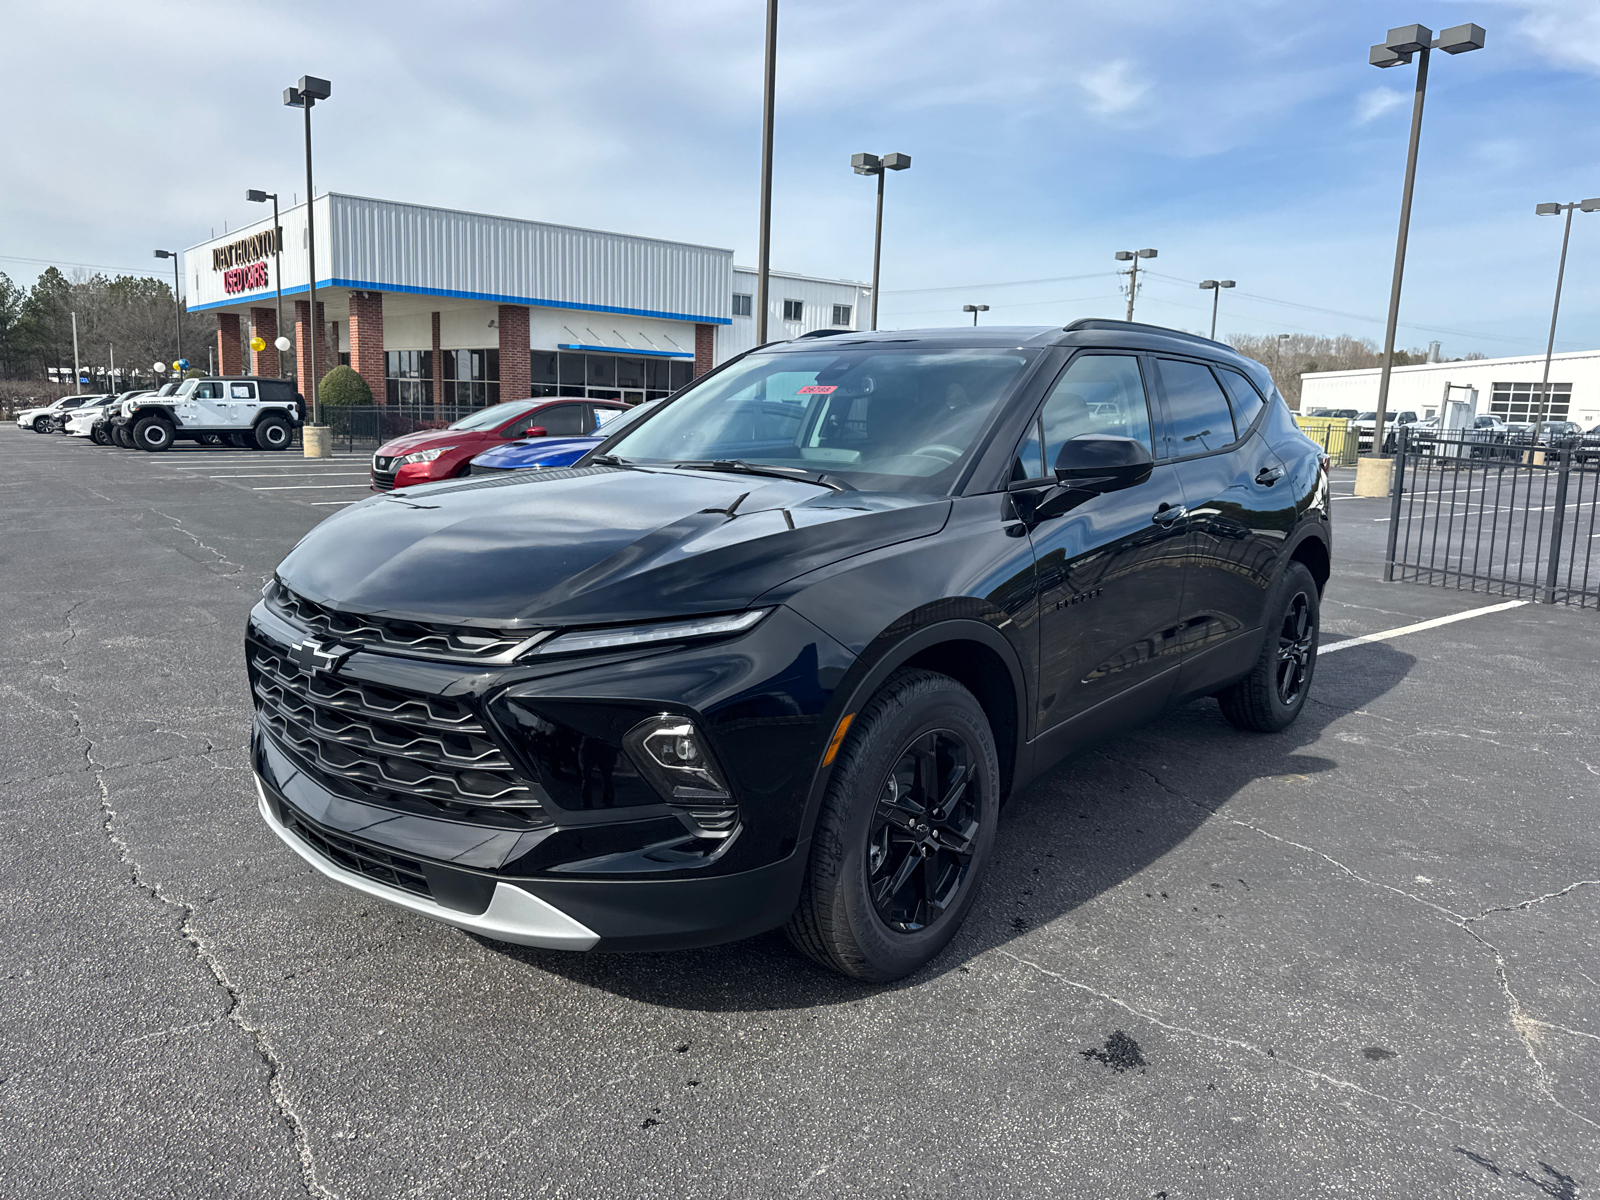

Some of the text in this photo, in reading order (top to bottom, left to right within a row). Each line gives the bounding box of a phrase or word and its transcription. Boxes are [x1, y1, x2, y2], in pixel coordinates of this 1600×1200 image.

[212, 245, 232, 271] JOHN
[224, 261, 267, 293] USED CARS
